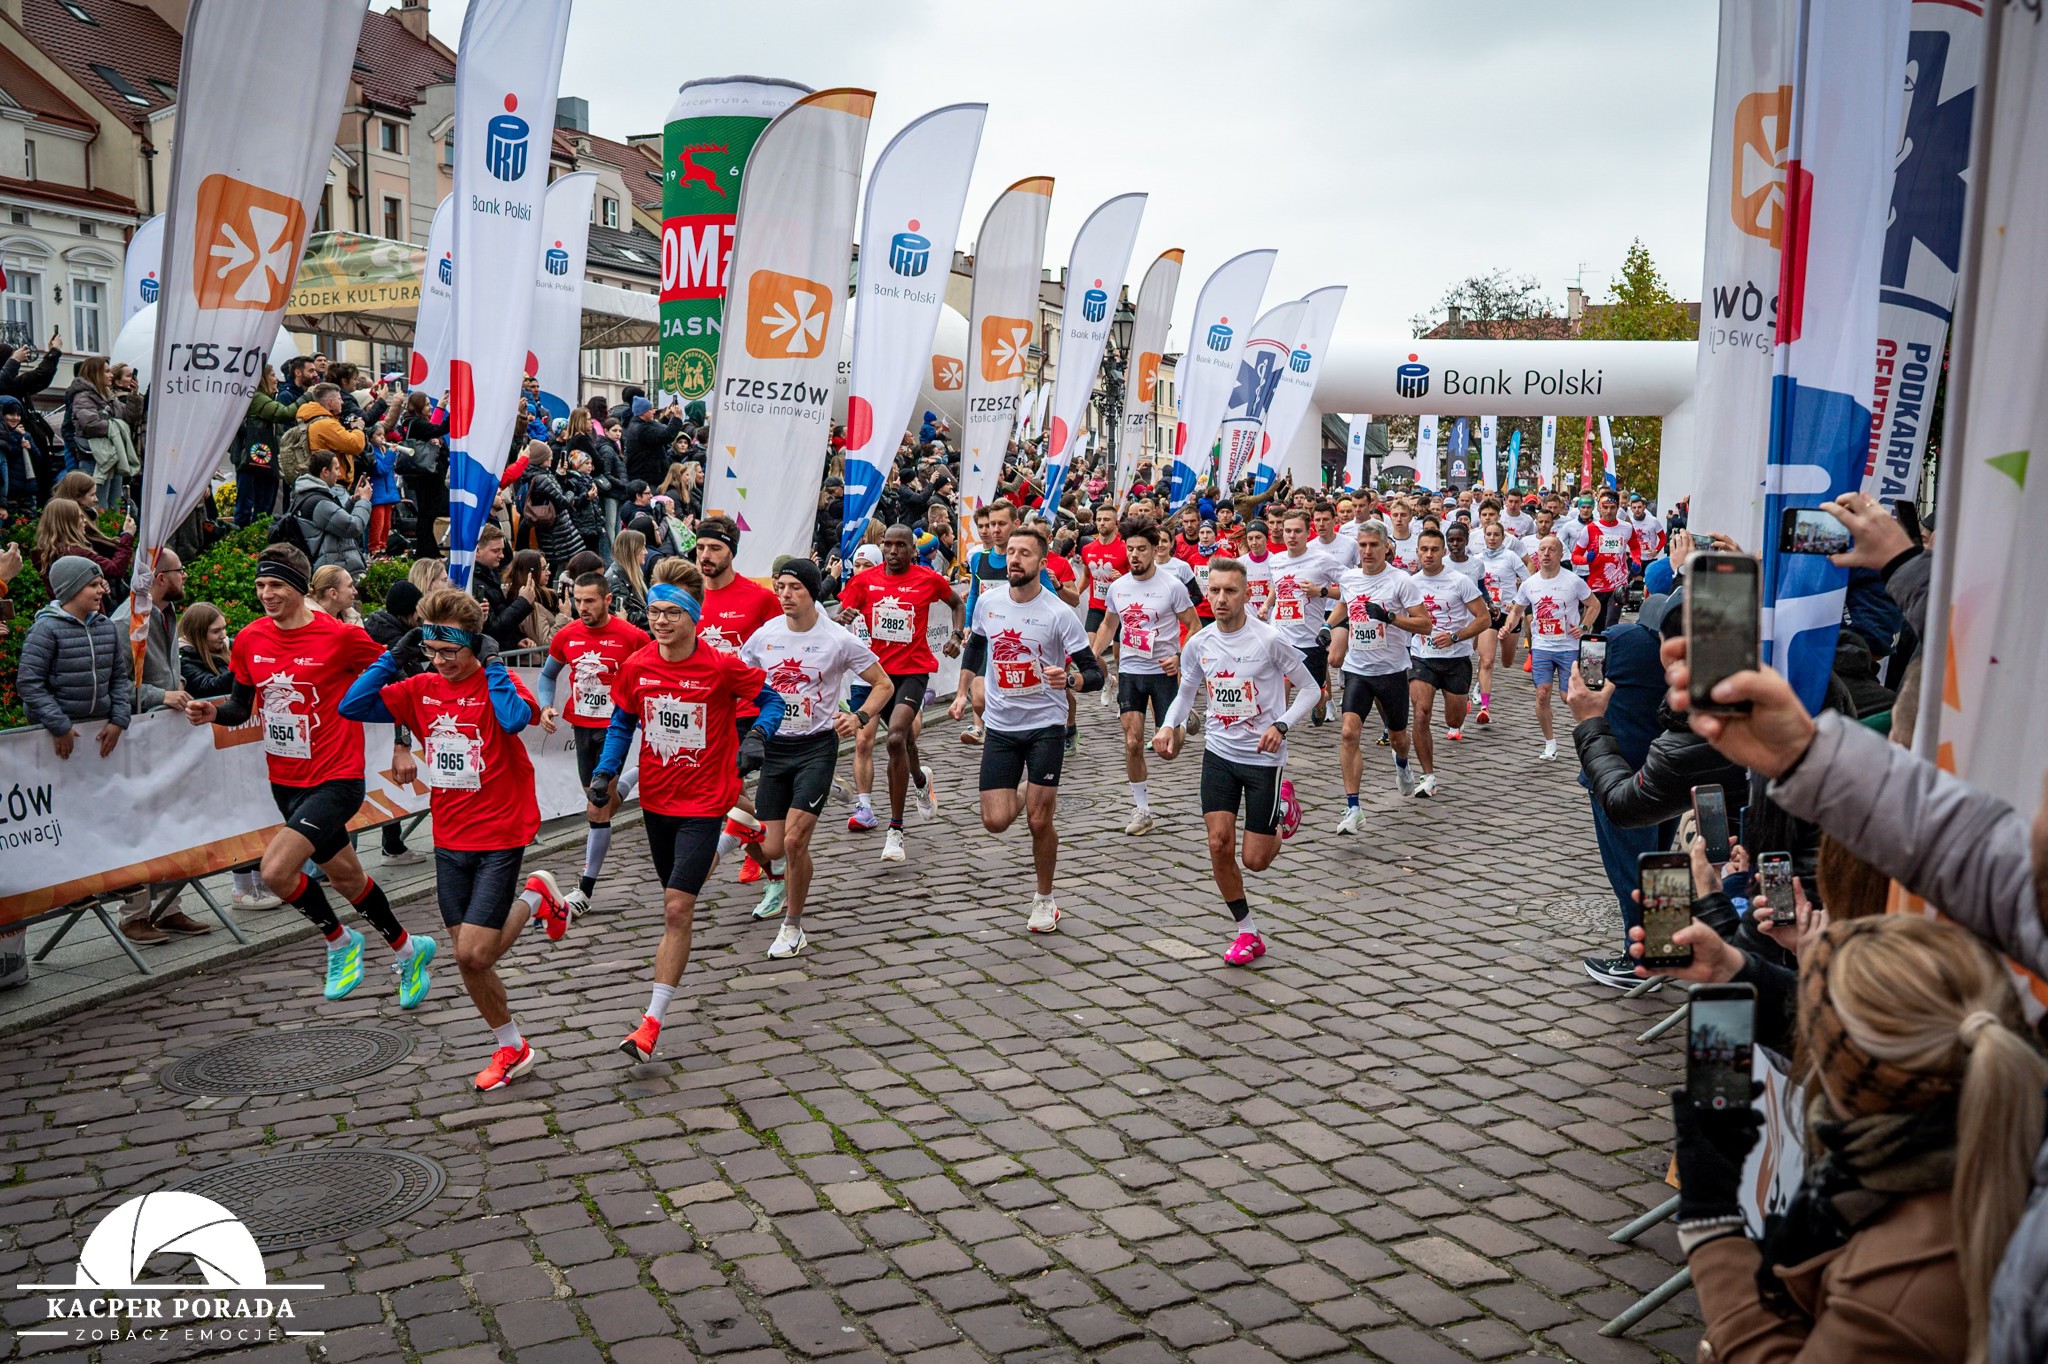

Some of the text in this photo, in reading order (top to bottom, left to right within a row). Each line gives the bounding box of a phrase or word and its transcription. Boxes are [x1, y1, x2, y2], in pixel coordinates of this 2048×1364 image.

[666, 170, 676, 182] 19
[472, 194, 532, 221] Bank Polski
[347, 285, 421, 304] KULTURA
[536, 279, 575, 293] Bank Polski
[874, 283, 936, 304] Bank Polski
[1070, 329, 1089, 340] Bank
[1443, 369, 1512, 395] Bank
[1524, 369, 1603, 395] Polski
[725, 377, 829, 406] rzeszów
[723, 400, 826, 425] stolica innowacji
[1604, 539, 1619, 547] 2952
[881, 617, 904, 631] 2882
[1354, 629, 1377, 640] 2948
[1005, 670, 1026, 684] 587
[583, 693, 607, 706] 2206
[1215, 688, 1242, 703] 2202
[658, 710, 689, 730] 1964
[268, 723, 295, 742] 1654
[436, 752, 464, 771] 1965
